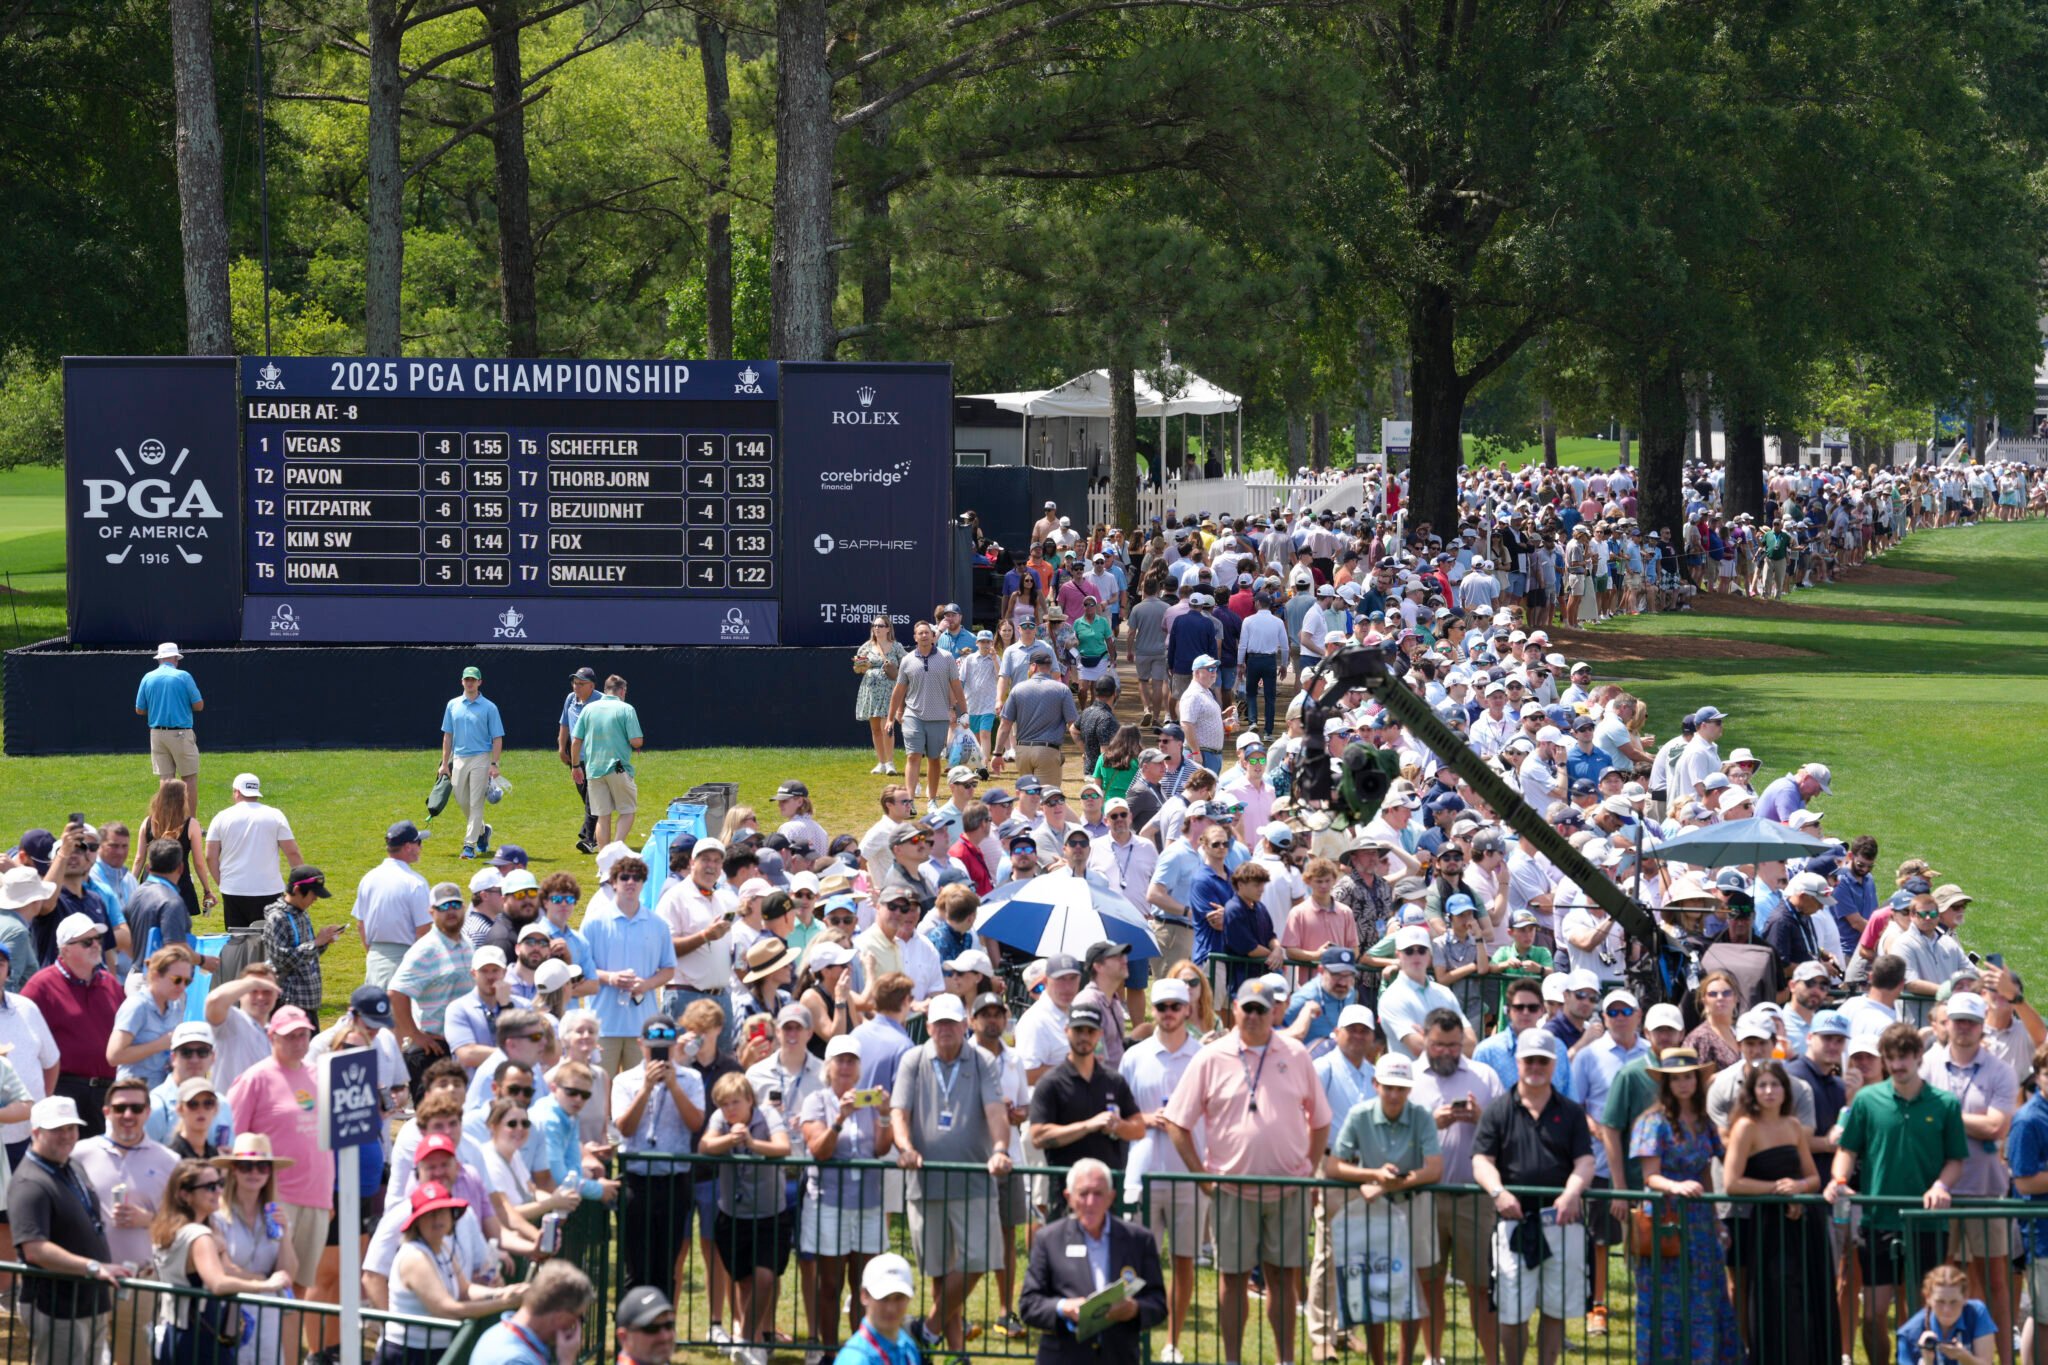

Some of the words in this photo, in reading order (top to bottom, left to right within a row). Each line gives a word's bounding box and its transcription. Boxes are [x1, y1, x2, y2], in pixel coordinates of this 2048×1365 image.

[256, 380, 285, 390] PGA
[331, 362, 397, 391] 2025
[409, 363, 465, 392] PGA
[474, 363, 689, 393] CHAMPIONSHIP
[734, 384, 764, 394] PGA
[249, 403, 311, 419] LEADER
[315, 404, 338, 420] AT:
[343, 405, 358, 420] -8
[832, 411, 900, 425] ROLEX
[260, 437, 269, 452] 1
[286, 437, 341, 453] VEGAS
[435, 439, 450, 454] -8
[473, 440, 502, 455] 1:55
[519, 440, 537, 455] T5
[551, 440, 638, 456] SCHEFFLER
[698, 441, 713, 456] -5
[736, 442, 765, 457] 1:44
[255, 469, 274, 484] T2
[286, 469, 342, 484] PAVON
[435, 471, 450, 486] -6
[473, 471, 502, 486] 1:55
[519, 471, 538, 486] T7
[550, 471, 650, 487] THORBJORN
[699, 473, 713, 488] -4
[736, 474, 765, 488] 1:33
[820, 468, 901, 487] corebridge
[83, 478, 223, 518] PGA
[255, 500, 274, 515] T2
[287, 500, 371, 516] FITZPATRK
[435, 503, 450, 517] -6
[473, 503, 502, 517] 1:55
[519, 503, 538, 517] T7
[551, 503, 644, 518] BEZUIDNHT
[699, 505, 713, 520] -4
[736, 505, 765, 520] 1:33
[99, 526, 122, 538] OF
[129, 526, 208, 538] AMERICA
[255, 532, 274, 546] T2
[287, 532, 319, 547] KIM
[324, 532, 352, 548] SW
[436, 534, 450, 549] -6
[474, 534, 502, 549] 1:44
[519, 534, 538, 549] T7
[551, 534, 582, 550] FOX
[699, 536, 713, 551] -4
[736, 537, 765, 551] 1:33
[139, 553, 169, 564] 1916
[256, 563, 274, 578] T5
[287, 563, 339, 579] HOMA
[436, 565, 450, 580] -5
[474, 565, 503, 580] 1:44
[519, 566, 538, 581] T7
[551, 566, 626, 582] SMALLEY
[699, 568, 713, 583] -4
[736, 568, 766, 583] 1:22
[841, 604, 887, 614] T-MOBILE
[270, 621, 299, 630] PGA
[841, 613, 860, 623] FOR
[493, 627, 528, 638] PGA
[720, 625, 750, 634] PGA
[333, 1083, 376, 1114] PGA
